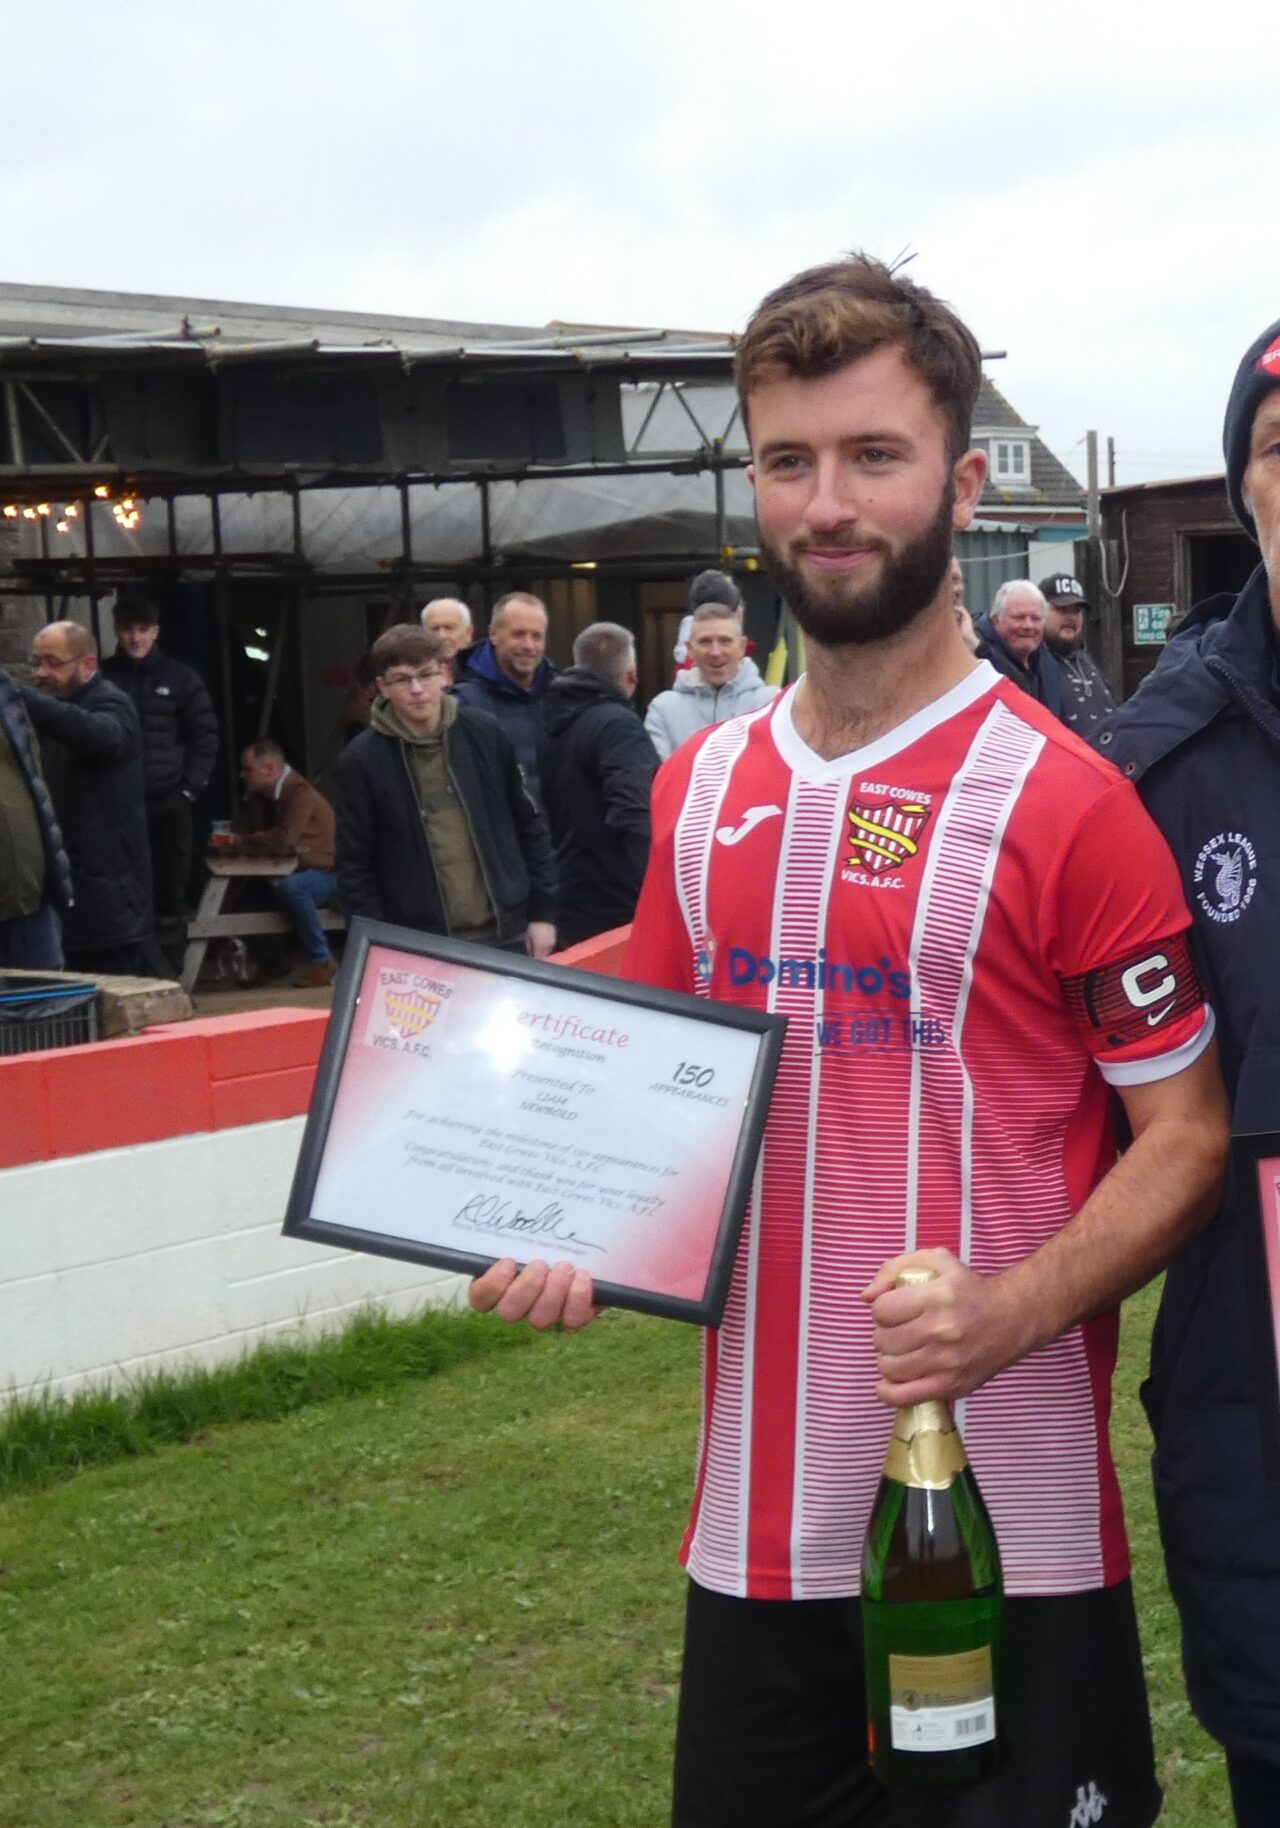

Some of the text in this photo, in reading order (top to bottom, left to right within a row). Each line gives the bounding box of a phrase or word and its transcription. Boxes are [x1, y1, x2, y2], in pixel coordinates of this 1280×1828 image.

[859, 782, 932, 804] EAST COWES
[1193, 832, 1257, 882] WESSEX LEAGUE
[841, 869, 870, 886] VICS.
[1196, 891, 1241, 923] FOUNDED
[380, 972, 453, 999] EAST COWES
[727, 947, 913, 1000] Domino's
[1121, 954, 1176, 1007] C
[516, 1009, 631, 1048] ertificate
[850, 1018, 895, 1045] GOT
[900, 1018, 946, 1045] THIS
[671, 1061, 715, 1088] 150
[578, 1082, 595, 1096] To
[648, 1082, 729, 1108] APPEARANCES
[518, 1101, 579, 1121] NEWBOLD
